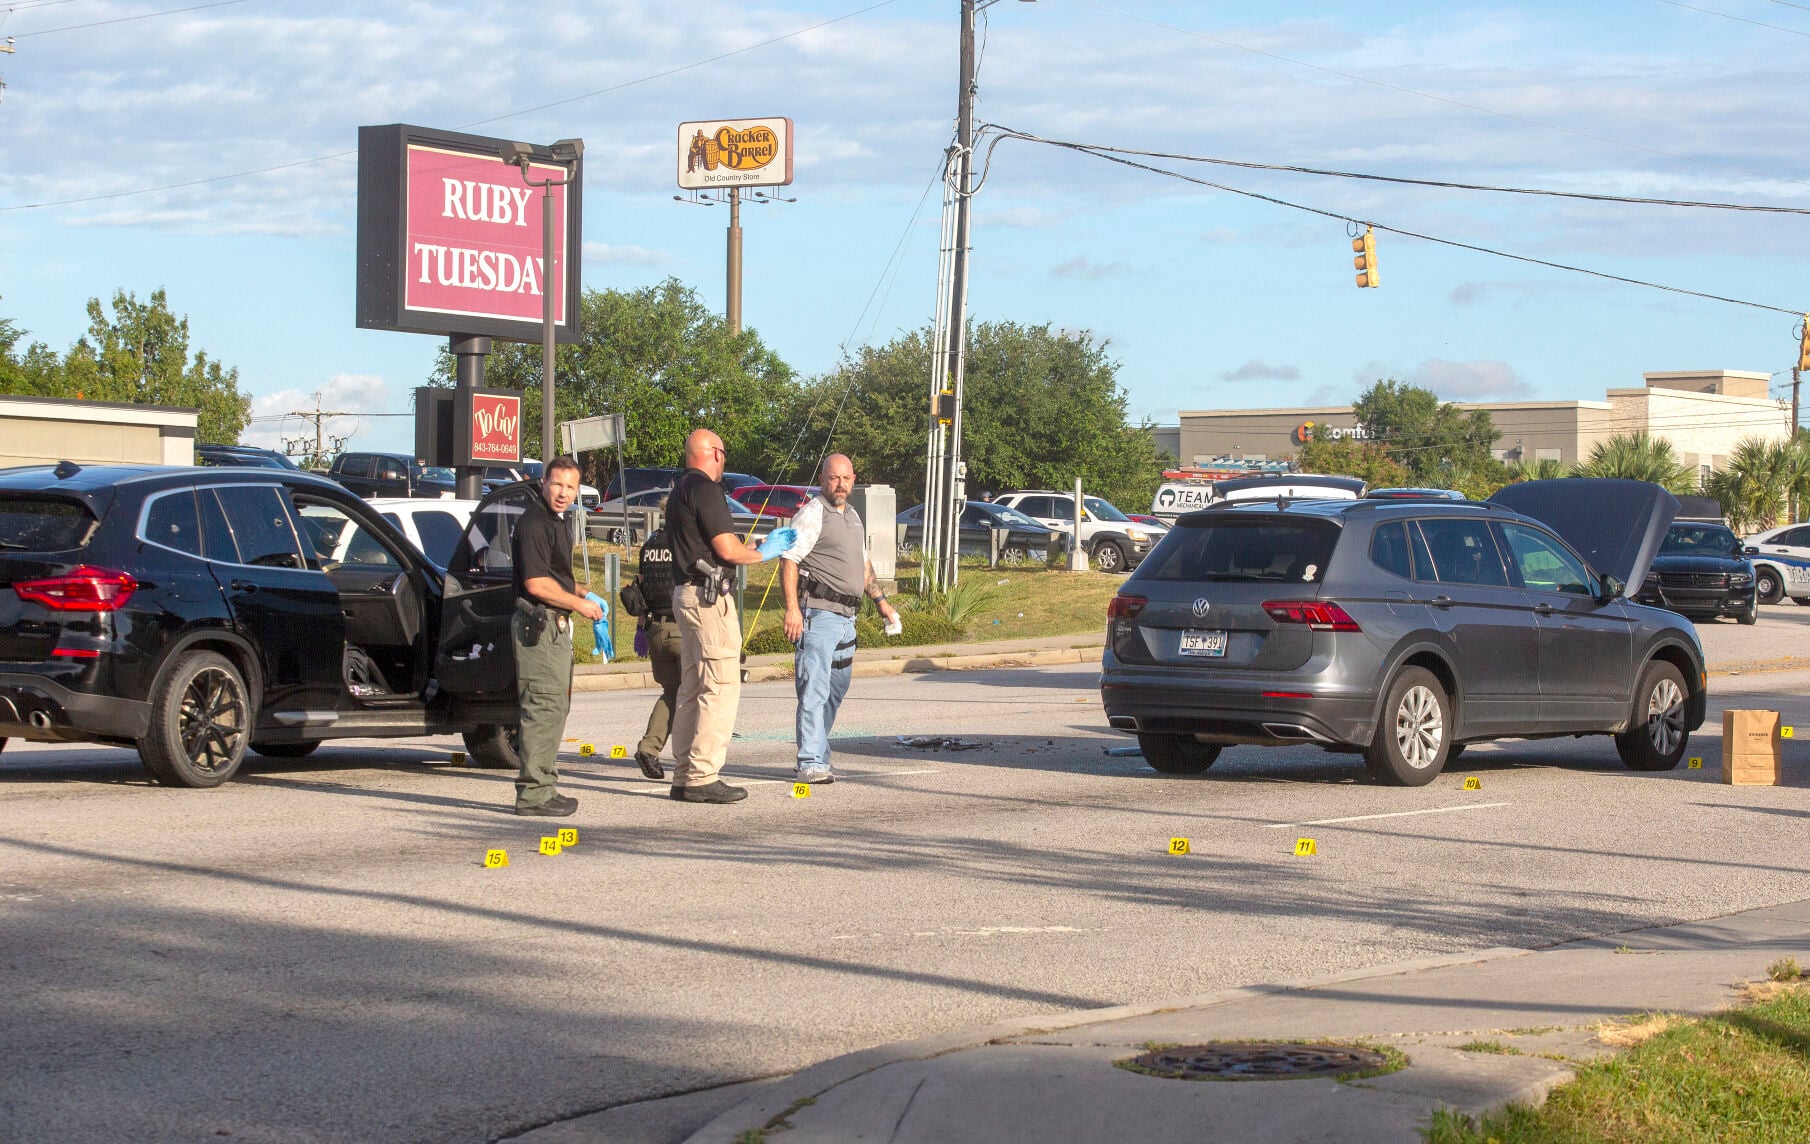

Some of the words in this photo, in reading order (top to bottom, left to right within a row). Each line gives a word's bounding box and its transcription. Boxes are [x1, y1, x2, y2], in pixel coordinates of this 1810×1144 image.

[714, 129, 769, 151] Cracker
[728, 143, 772, 168] Barrel
[717, 174, 741, 182] Country
[441, 177, 533, 227] RUBY
[474, 408, 493, 440] To
[493, 403, 517, 441] Go!
[474, 442, 517, 455] 843-764-0649
[1177, 490, 1215, 504] TEAM
[1784, 728, 1790, 736] 7
[613, 747, 623, 756] 17
[1691, 759, 1698, 767] 9
[1466, 779, 1476, 788] 10
[795, 785, 806, 795] 16
[560, 831, 574, 843] 13
[543, 840, 556, 852] 14
[1172, 840, 1185, 851] 12
[1300, 841, 1311, 851] 11
[488, 853, 502, 865] 15
